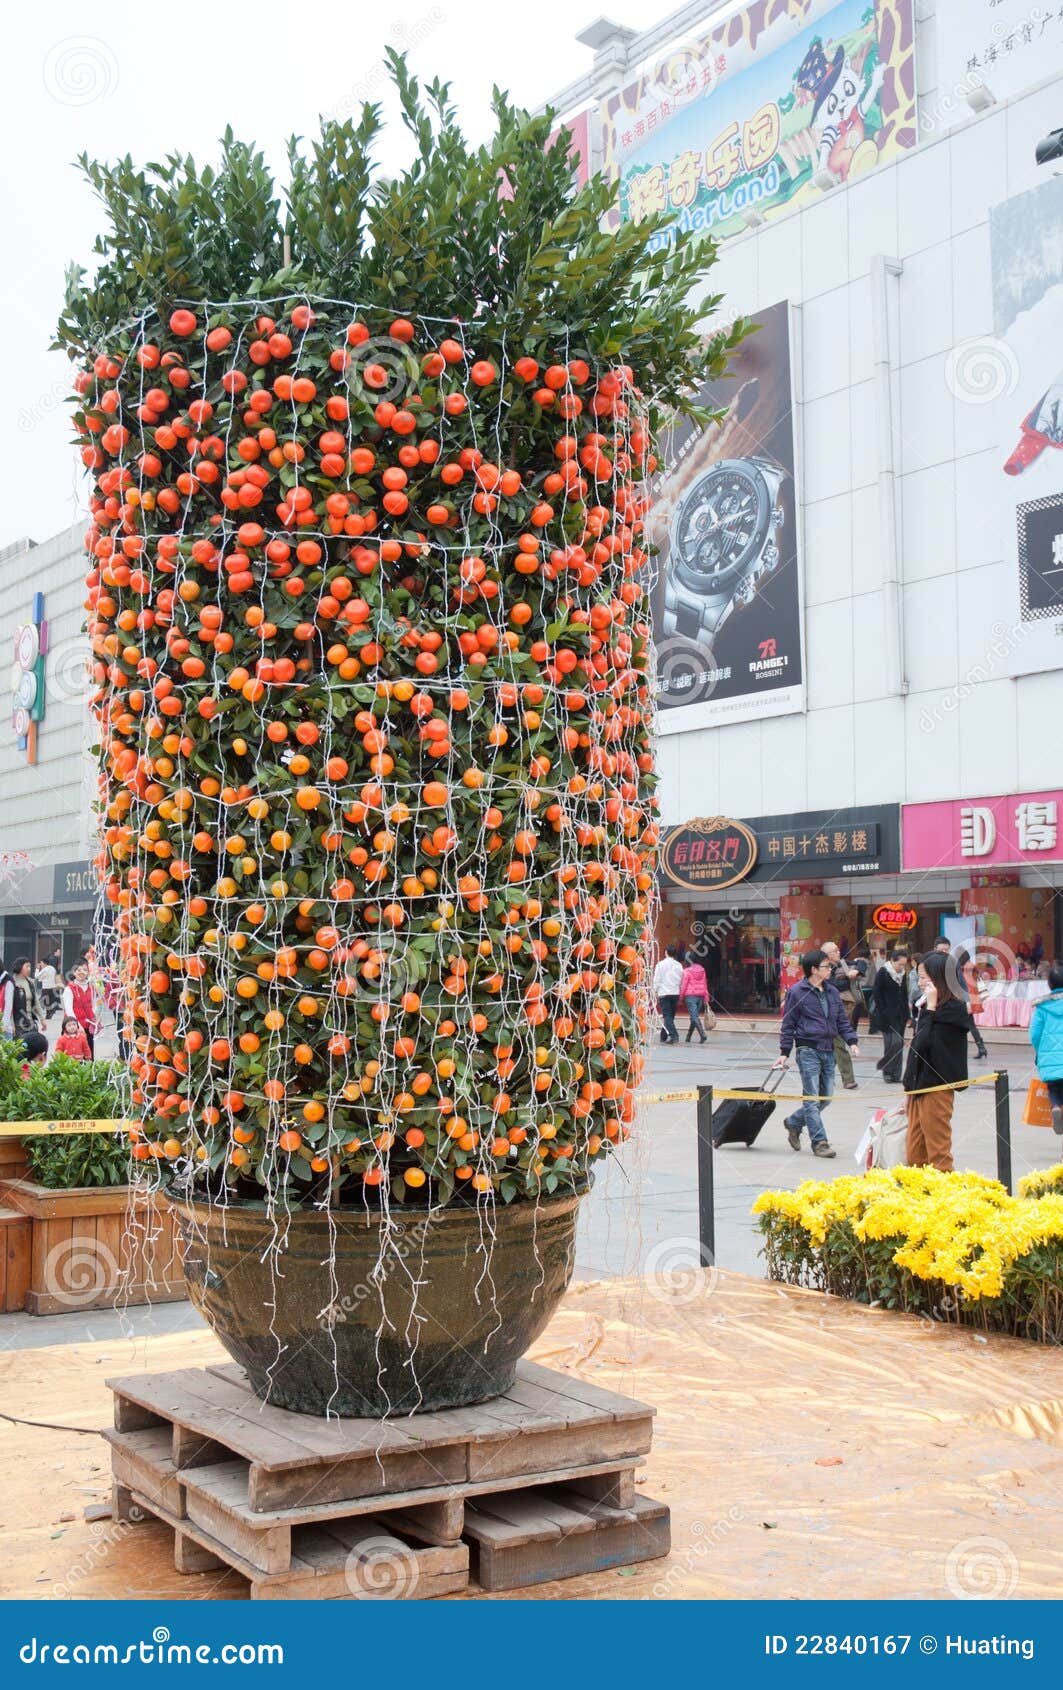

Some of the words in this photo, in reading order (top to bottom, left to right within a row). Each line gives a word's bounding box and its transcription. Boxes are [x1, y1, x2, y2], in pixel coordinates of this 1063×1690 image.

[768, 830, 867, 857] 中国十杰影楼
